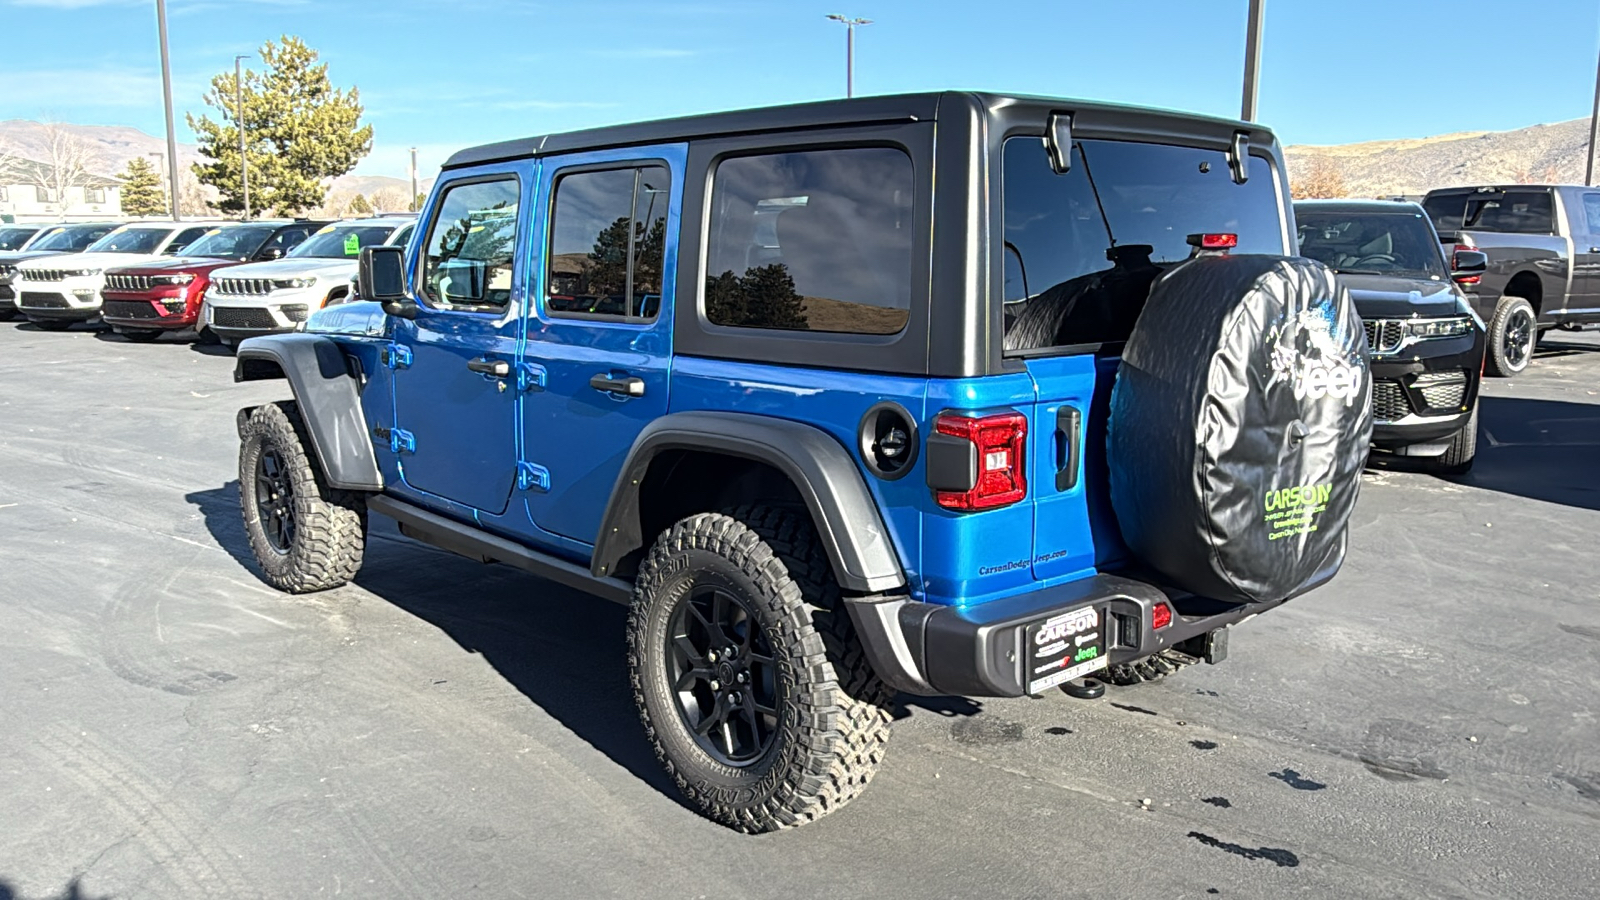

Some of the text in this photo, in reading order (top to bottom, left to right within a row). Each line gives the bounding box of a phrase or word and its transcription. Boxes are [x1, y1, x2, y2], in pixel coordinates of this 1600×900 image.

[1294, 359, 1361, 407] Jeep
[1264, 483, 1333, 512] CARSON
[1035, 609, 1098, 645] CARSON
[1074, 646, 1098, 662] Jeep
